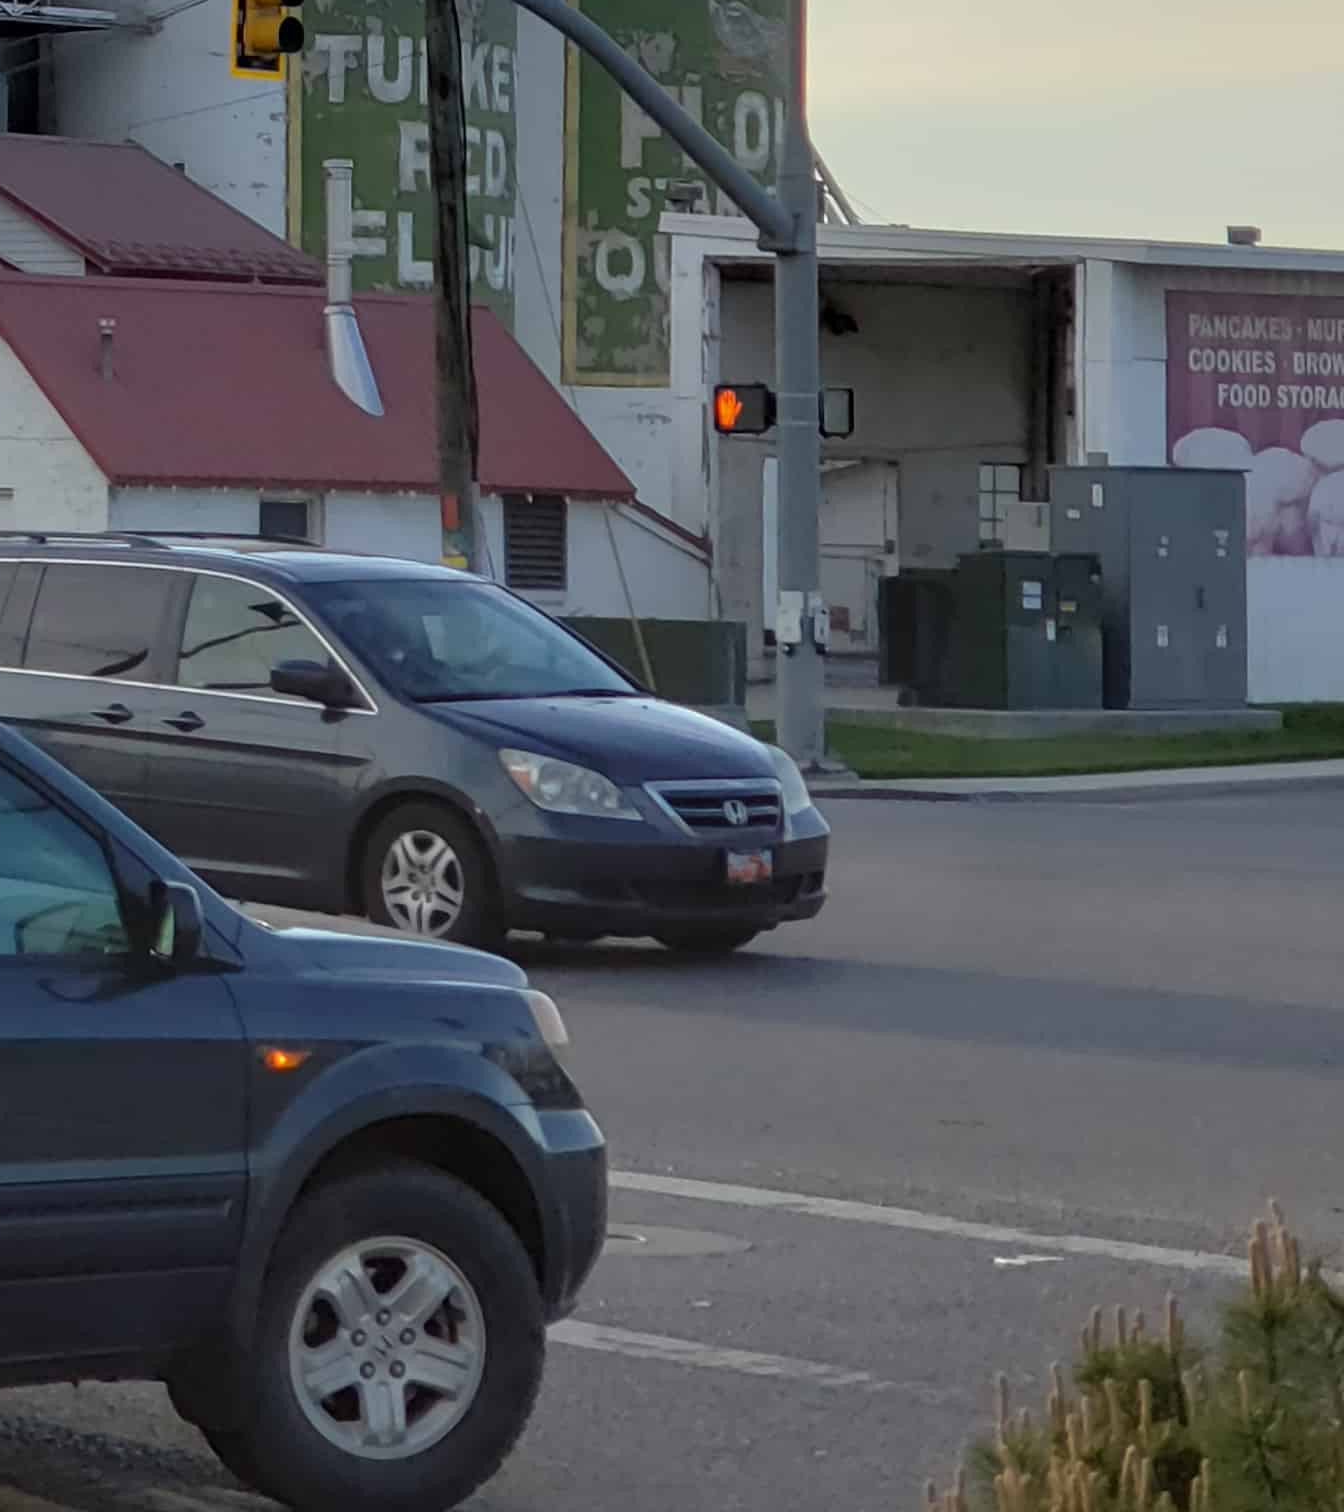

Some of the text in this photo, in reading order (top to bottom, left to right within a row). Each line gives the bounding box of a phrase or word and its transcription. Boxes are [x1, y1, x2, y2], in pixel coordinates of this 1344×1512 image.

[1189, 314, 1292, 341] PANCAKES
[1188, 348, 1276, 374] COOKIES
[1217, 383, 1271, 408] FOOD
